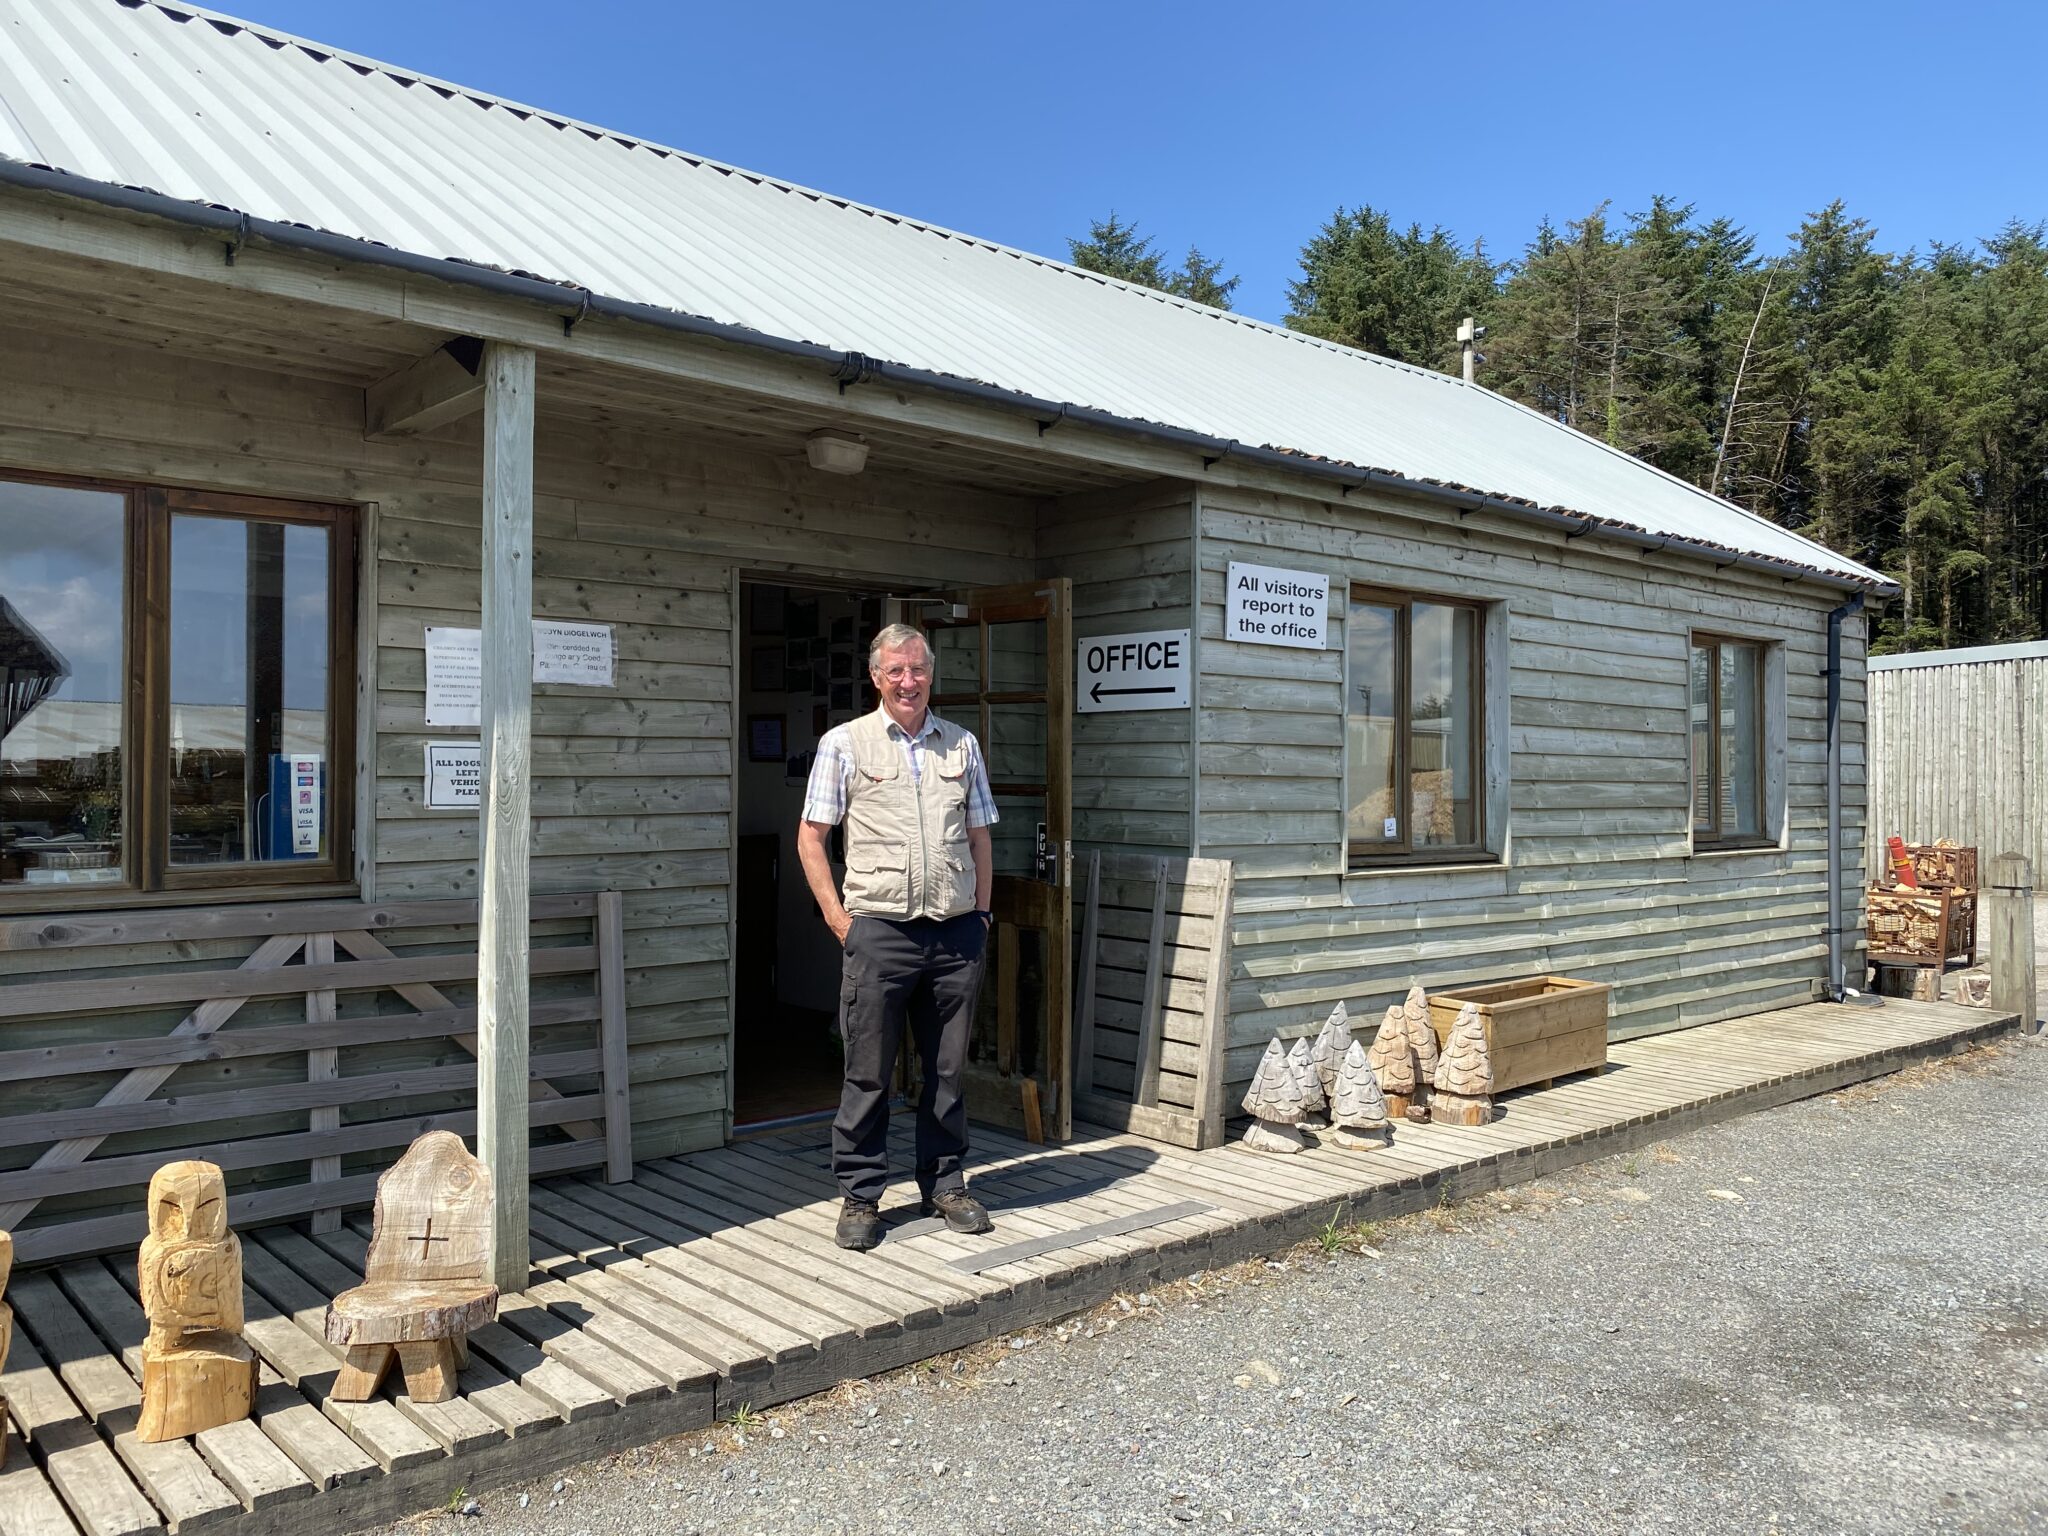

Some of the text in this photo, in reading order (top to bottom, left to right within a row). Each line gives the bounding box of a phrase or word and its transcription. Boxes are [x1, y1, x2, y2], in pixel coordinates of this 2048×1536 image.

[1238, 576, 1325, 600] All visitors
[1242, 599, 1315, 617] report to
[1239, 618, 1317, 639] the office
[1087, 640, 1180, 674] OFFICE
